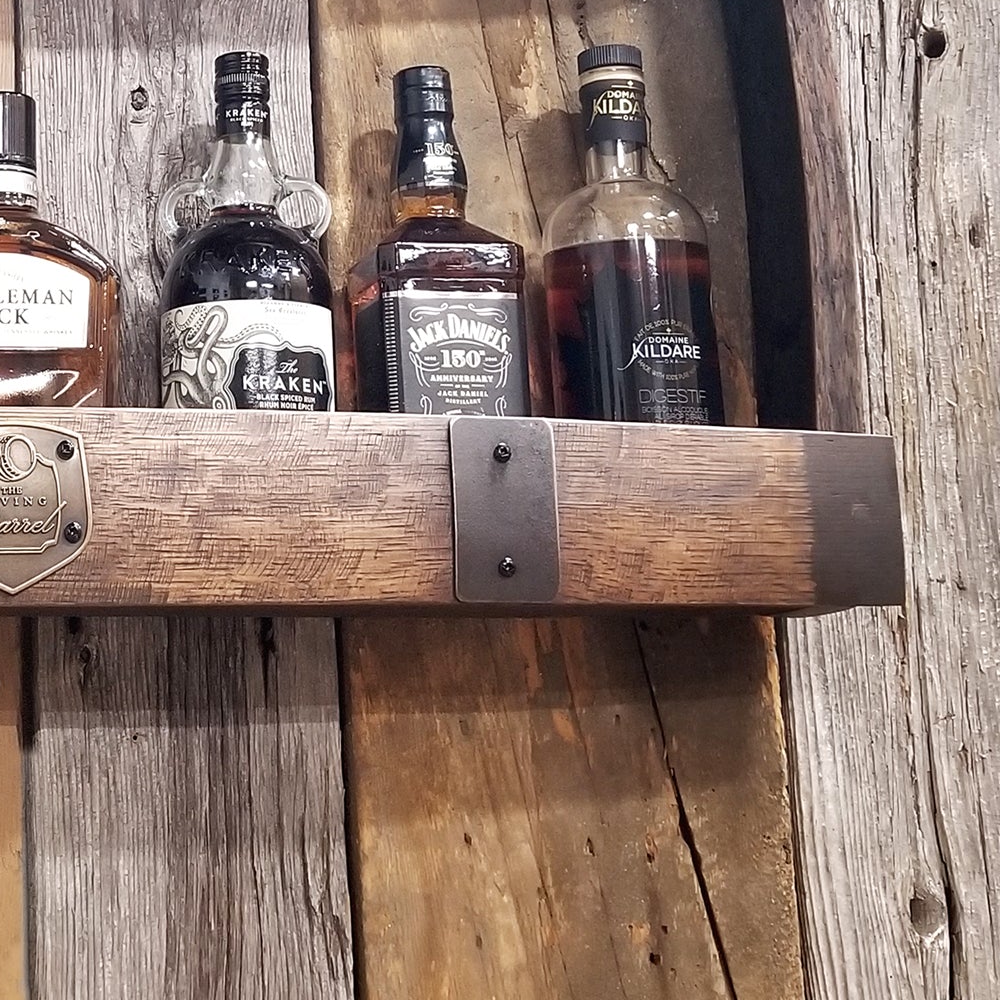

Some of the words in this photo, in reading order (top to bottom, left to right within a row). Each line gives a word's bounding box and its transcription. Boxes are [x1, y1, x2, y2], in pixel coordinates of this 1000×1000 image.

[607, 90, 638, 99] DOMA
[225, 108, 267, 119] KRAKEN
[406, 320, 449, 353] JACK
[447, 313, 511, 355] DANIEL'S
[634, 328, 647, 342] FAIT
[644, 322, 655, 332] DE
[648, 336, 689, 345] DOMAINE
[628, 341, 701, 364] KILDARE
[276, 358, 299, 375] The
[429, 374, 494, 383] ANNIVERSARY
[651, 370, 665, 380] WITH
[242, 374, 323, 395] KRAKEN
[255, 393, 280, 402] BLACK
[280, 394, 302, 403] SPICED
[303, 396, 316, 404] RUM
[638, 388, 707, 404] DIGESTIF
[259, 401, 280, 409] RHUM
[280, 402, 298, 410] NOIR
[1, 486, 23, 495] THE
